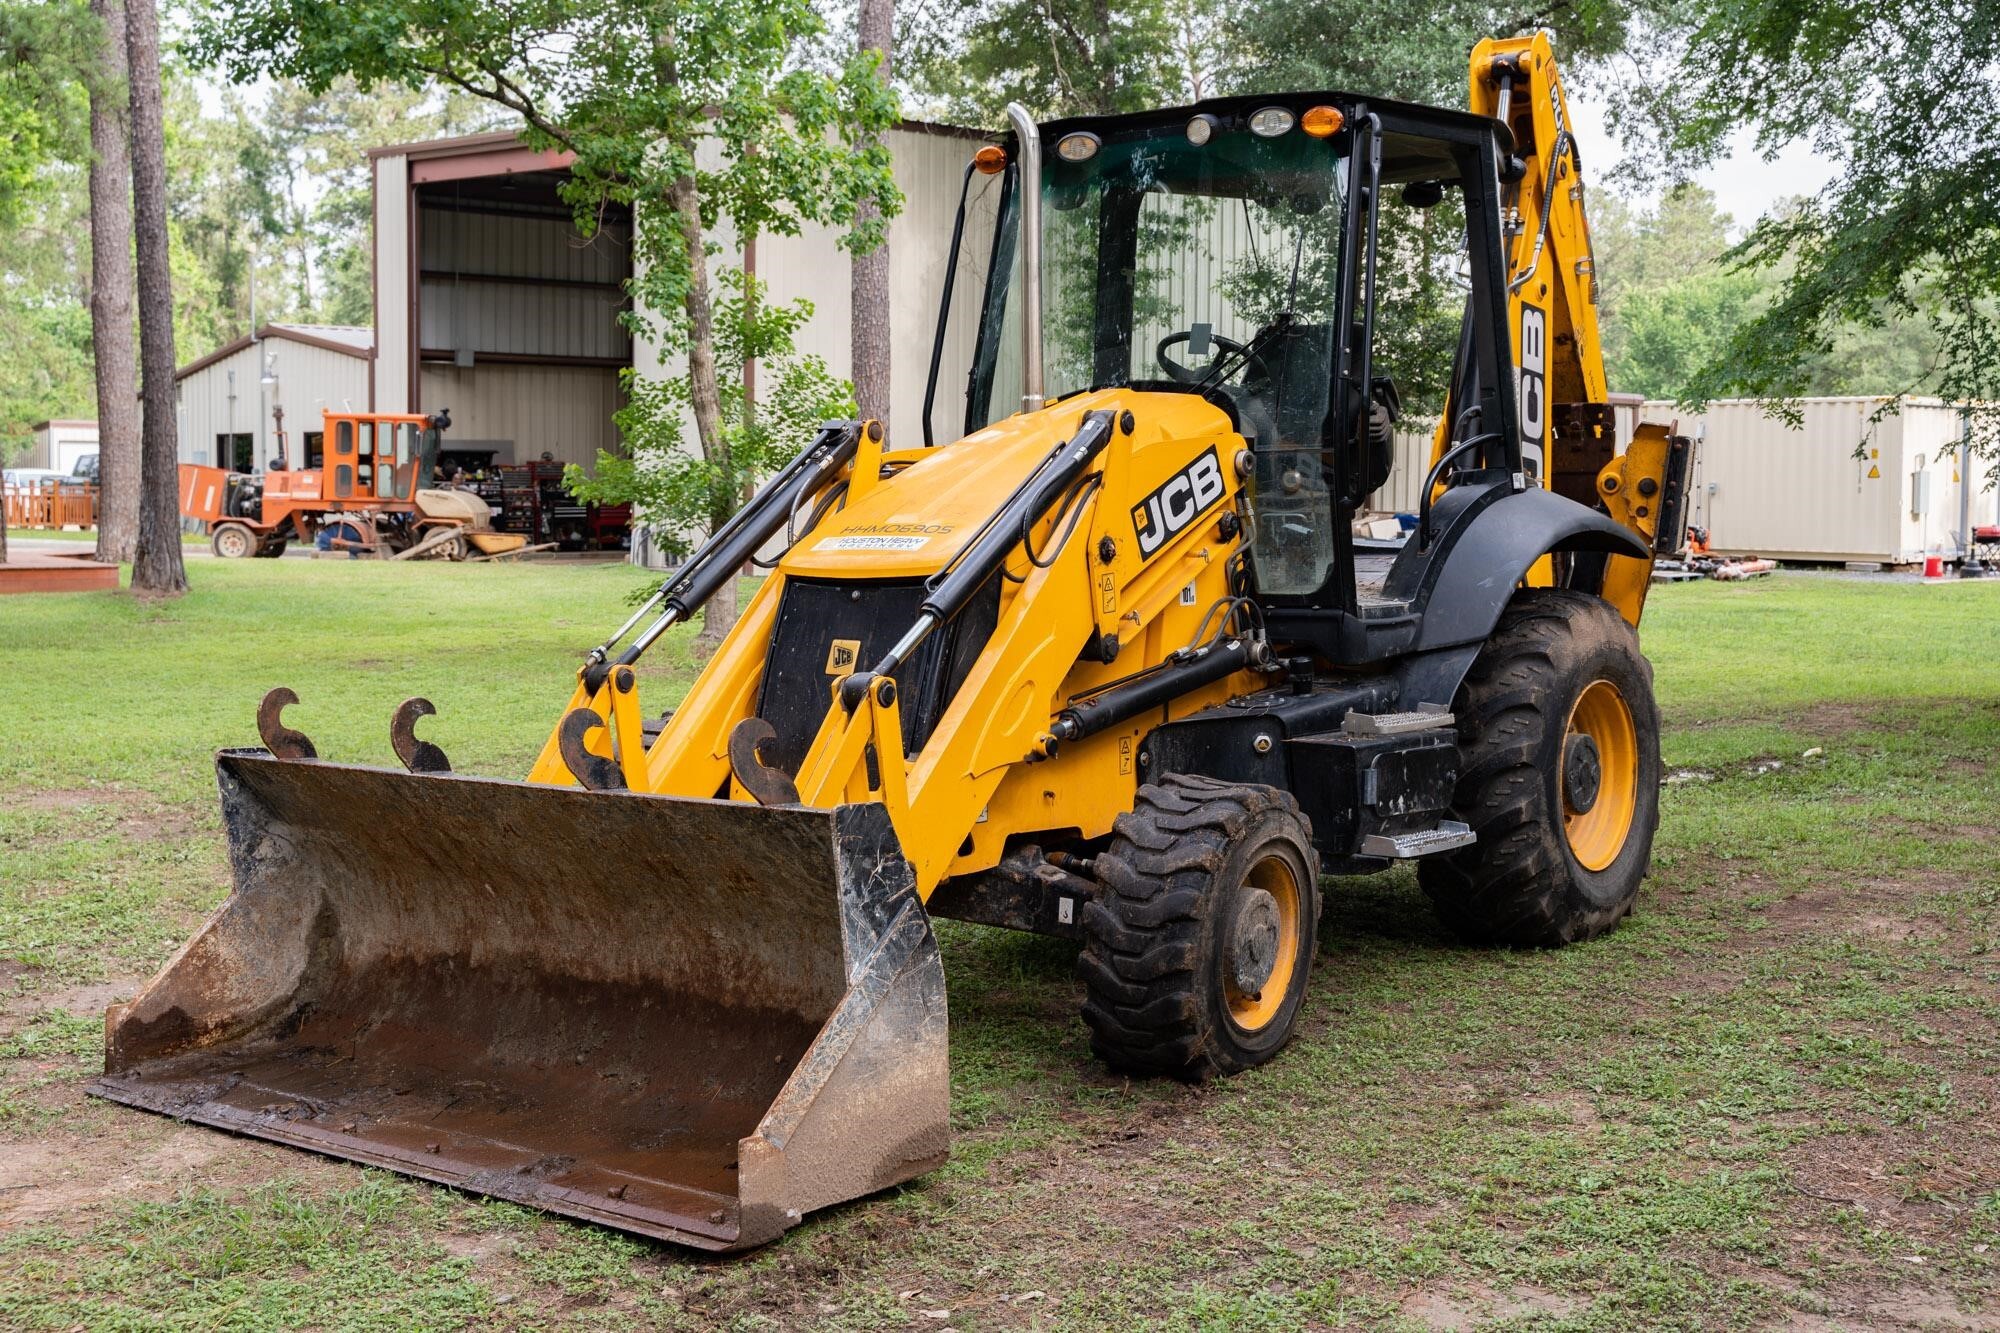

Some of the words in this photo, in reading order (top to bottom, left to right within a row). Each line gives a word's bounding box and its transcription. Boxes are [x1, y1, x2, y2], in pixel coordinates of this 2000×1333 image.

[1521, 309, 1543, 489] JCB
[840, 524, 955, 535] HHM06905
[1140, 453, 1223, 553] JCB
[835, 648, 852, 665] JCB
